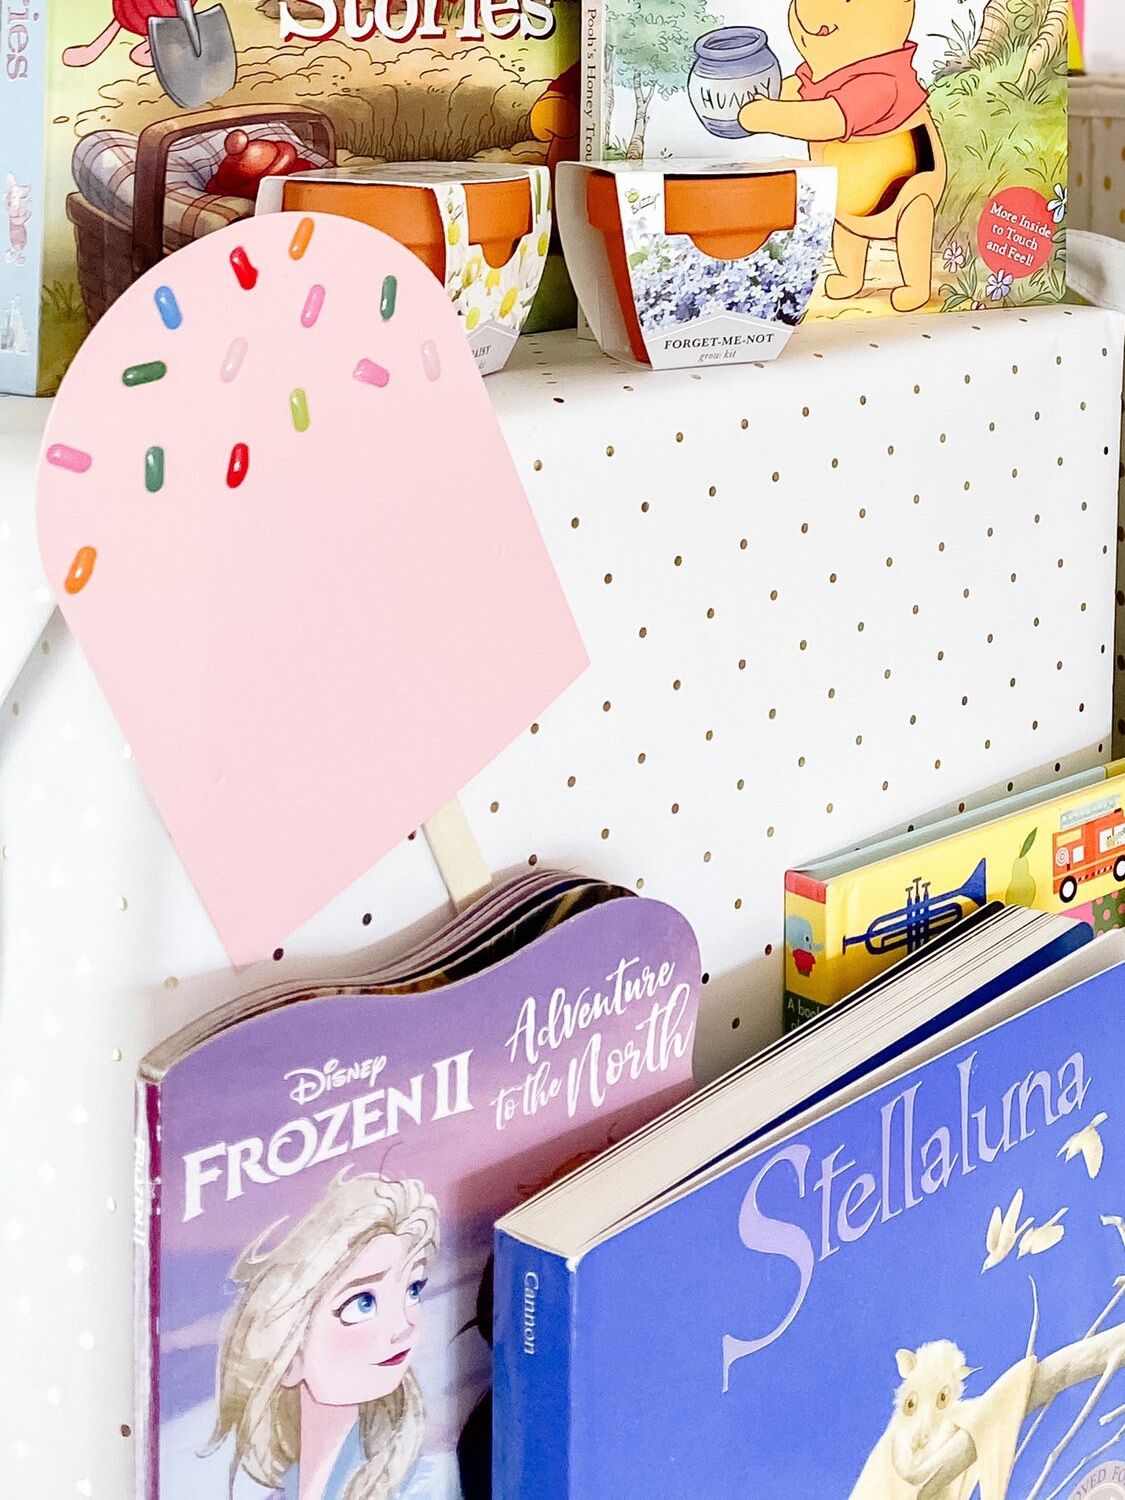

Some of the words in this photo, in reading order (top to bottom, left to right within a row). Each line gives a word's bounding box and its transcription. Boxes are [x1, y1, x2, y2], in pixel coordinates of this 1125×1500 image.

[584, 66, 596, 118] Honey
[585, 123, 596, 162] Trou
[989, 202, 1018, 224] More
[1019, 215, 1052, 238] Inside
[992, 224, 1004, 235] to
[1006, 227, 1038, 251] Touch
[986, 241, 1008, 256] and
[1007, 247, 1034, 267] Feel!
[664, 334, 774, 350] FORGET-ME-NOT
[698, 352, 721, 363] grow
[722, 350, 737, 359] kit
[505, 957, 675, 1064] Adventure
[787, 997, 795, 1013] A
[490, 1087, 521, 1130] to
[522, 1062, 563, 1115] the
[567, 983, 694, 1118] North
[181, 1076, 424, 1222] FROZEN
[426, 1050, 475, 1126] II
[722, 1047, 1093, 1393] Stellaluna
[521, 1271, 540, 1355] Cannon
